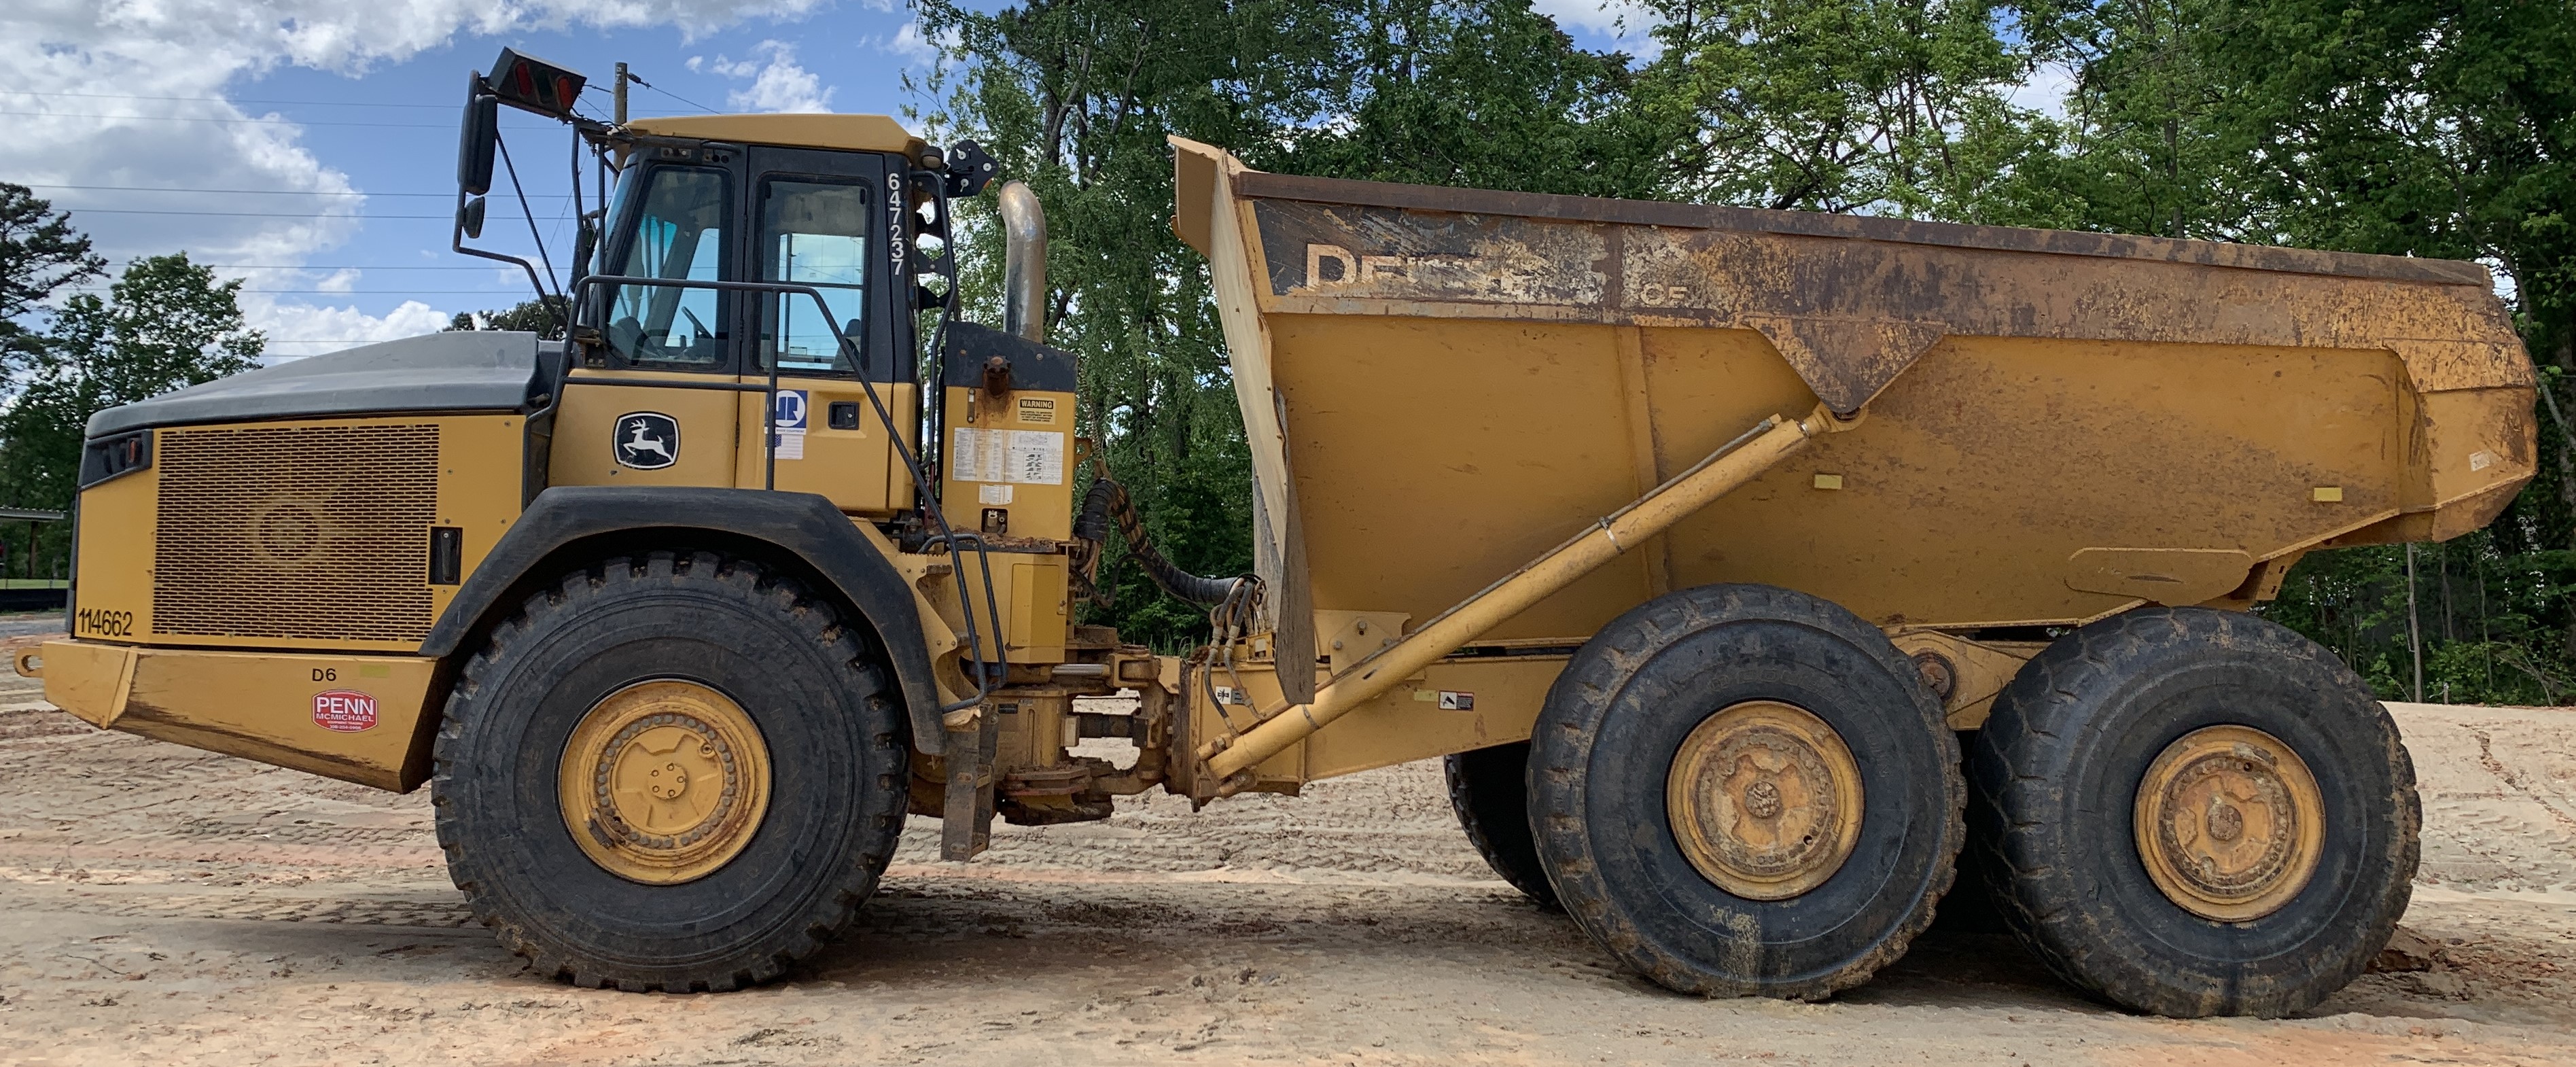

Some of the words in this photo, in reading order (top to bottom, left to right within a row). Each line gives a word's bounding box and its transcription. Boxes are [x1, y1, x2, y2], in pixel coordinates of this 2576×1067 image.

[888, 173, 904, 275] 647237
[1021, 400, 1053, 408] WARNING
[79, 608, 133, 637] 114662
[312, 668, 336, 682] D6
[316, 697, 374, 715] PENN
[316, 713, 374, 722] MCMICHAEL
